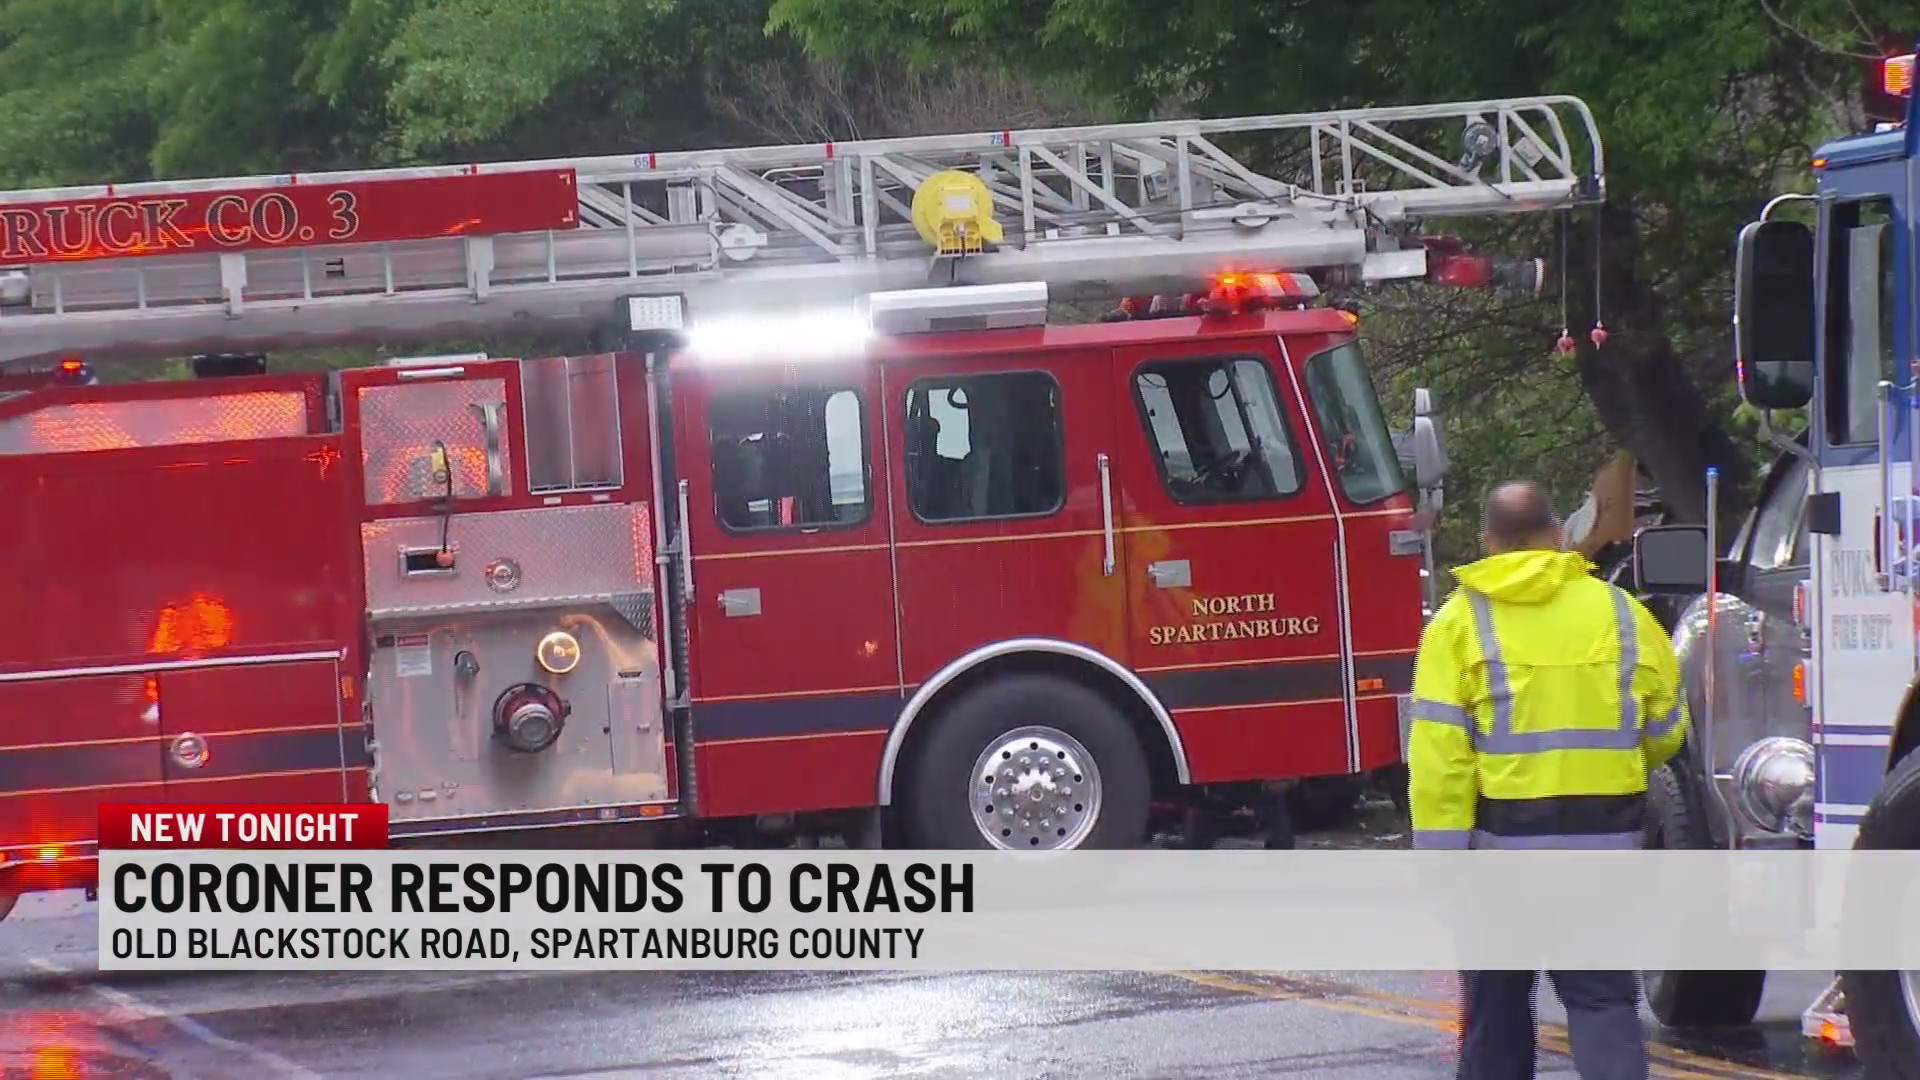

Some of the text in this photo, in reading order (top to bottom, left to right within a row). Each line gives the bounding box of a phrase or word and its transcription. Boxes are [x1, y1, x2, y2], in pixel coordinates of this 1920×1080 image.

[0, 189, 360, 258] RUCK CO. 3
[1830, 550, 1876, 597] DUNC
[1192, 592, 1277, 616] NORTH
[1149, 615, 1321, 646] SPARTANBURG
[1831, 613, 1858, 650] FIRE
